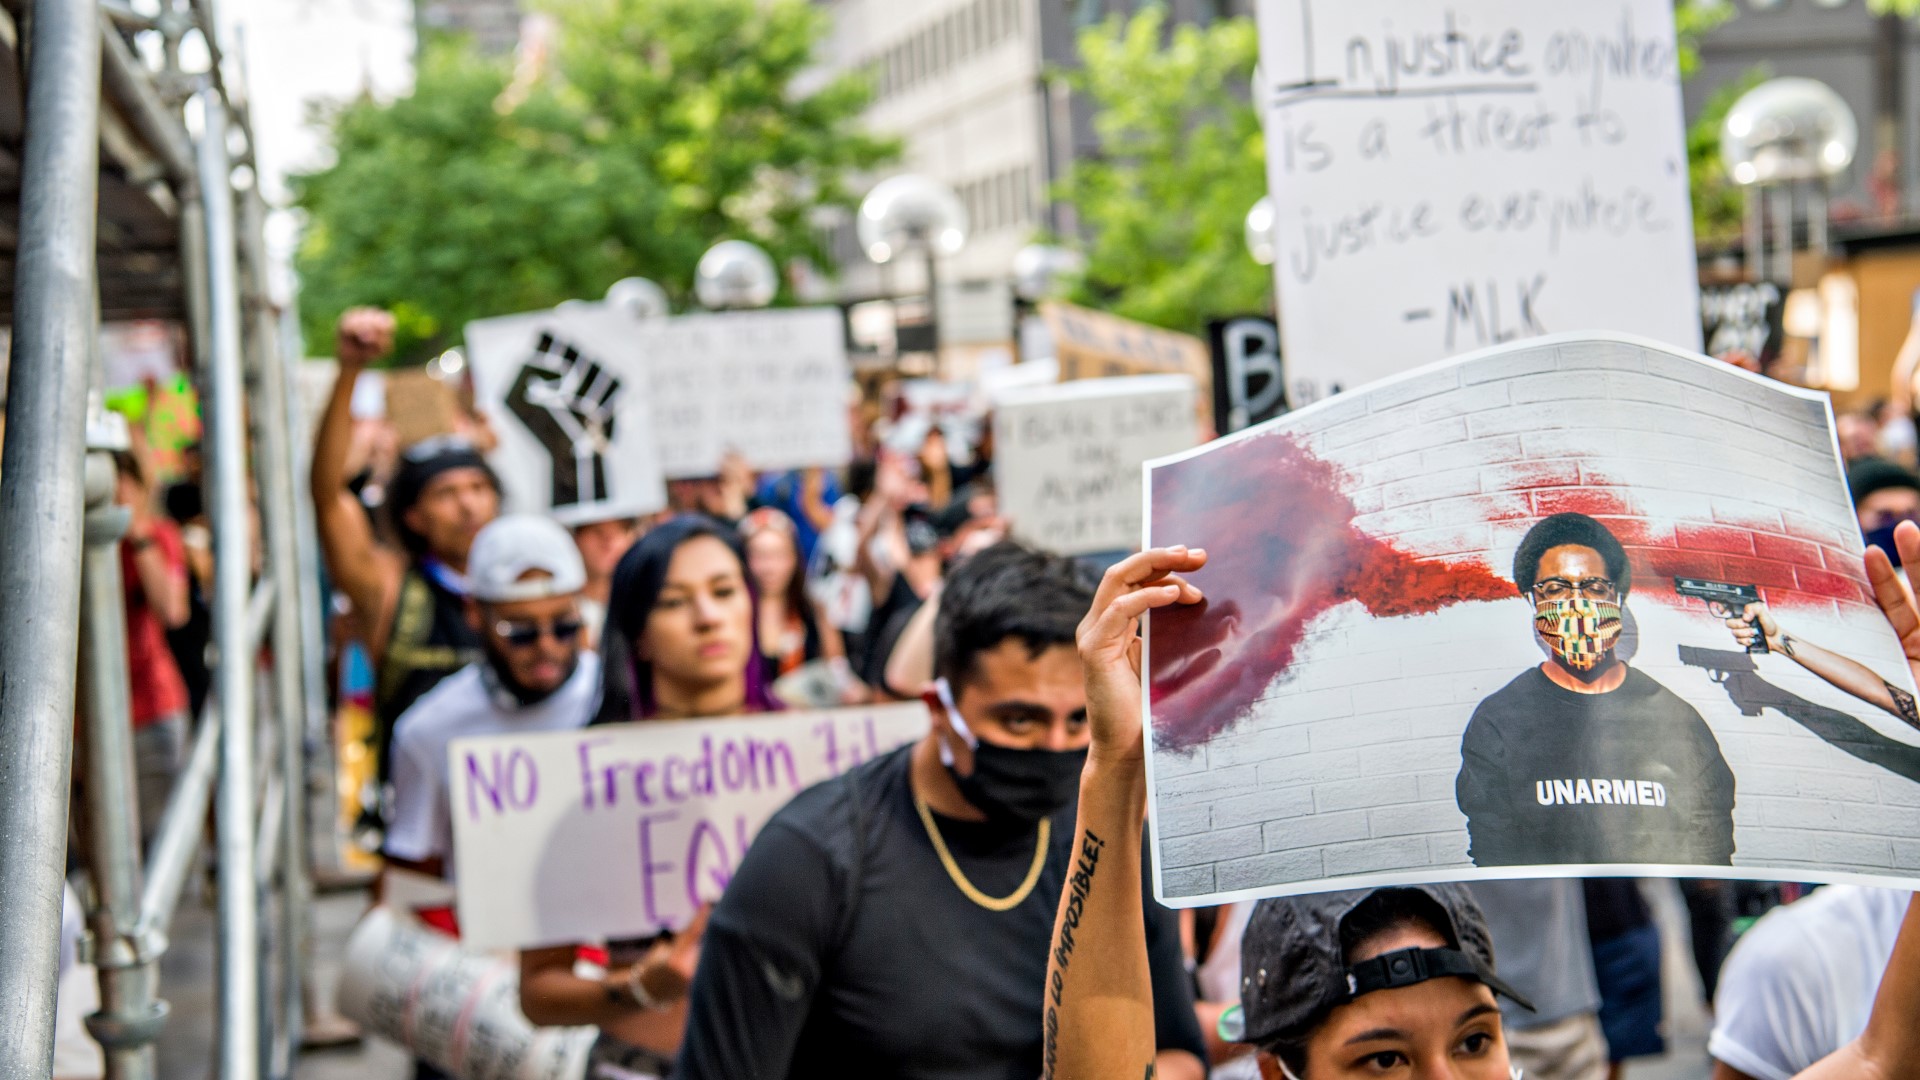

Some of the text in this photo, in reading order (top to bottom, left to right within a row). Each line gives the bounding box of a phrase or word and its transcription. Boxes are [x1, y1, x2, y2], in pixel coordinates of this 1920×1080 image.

[1275, 0, 1531, 95] Injustice
[1283, 97, 1627, 173] is a threat to
[1291, 200, 1441, 283] justice
[463, 747, 539, 822] NO
[577, 735, 801, 811] Freedom
[1536, 778, 1666, 808] UNARMED
